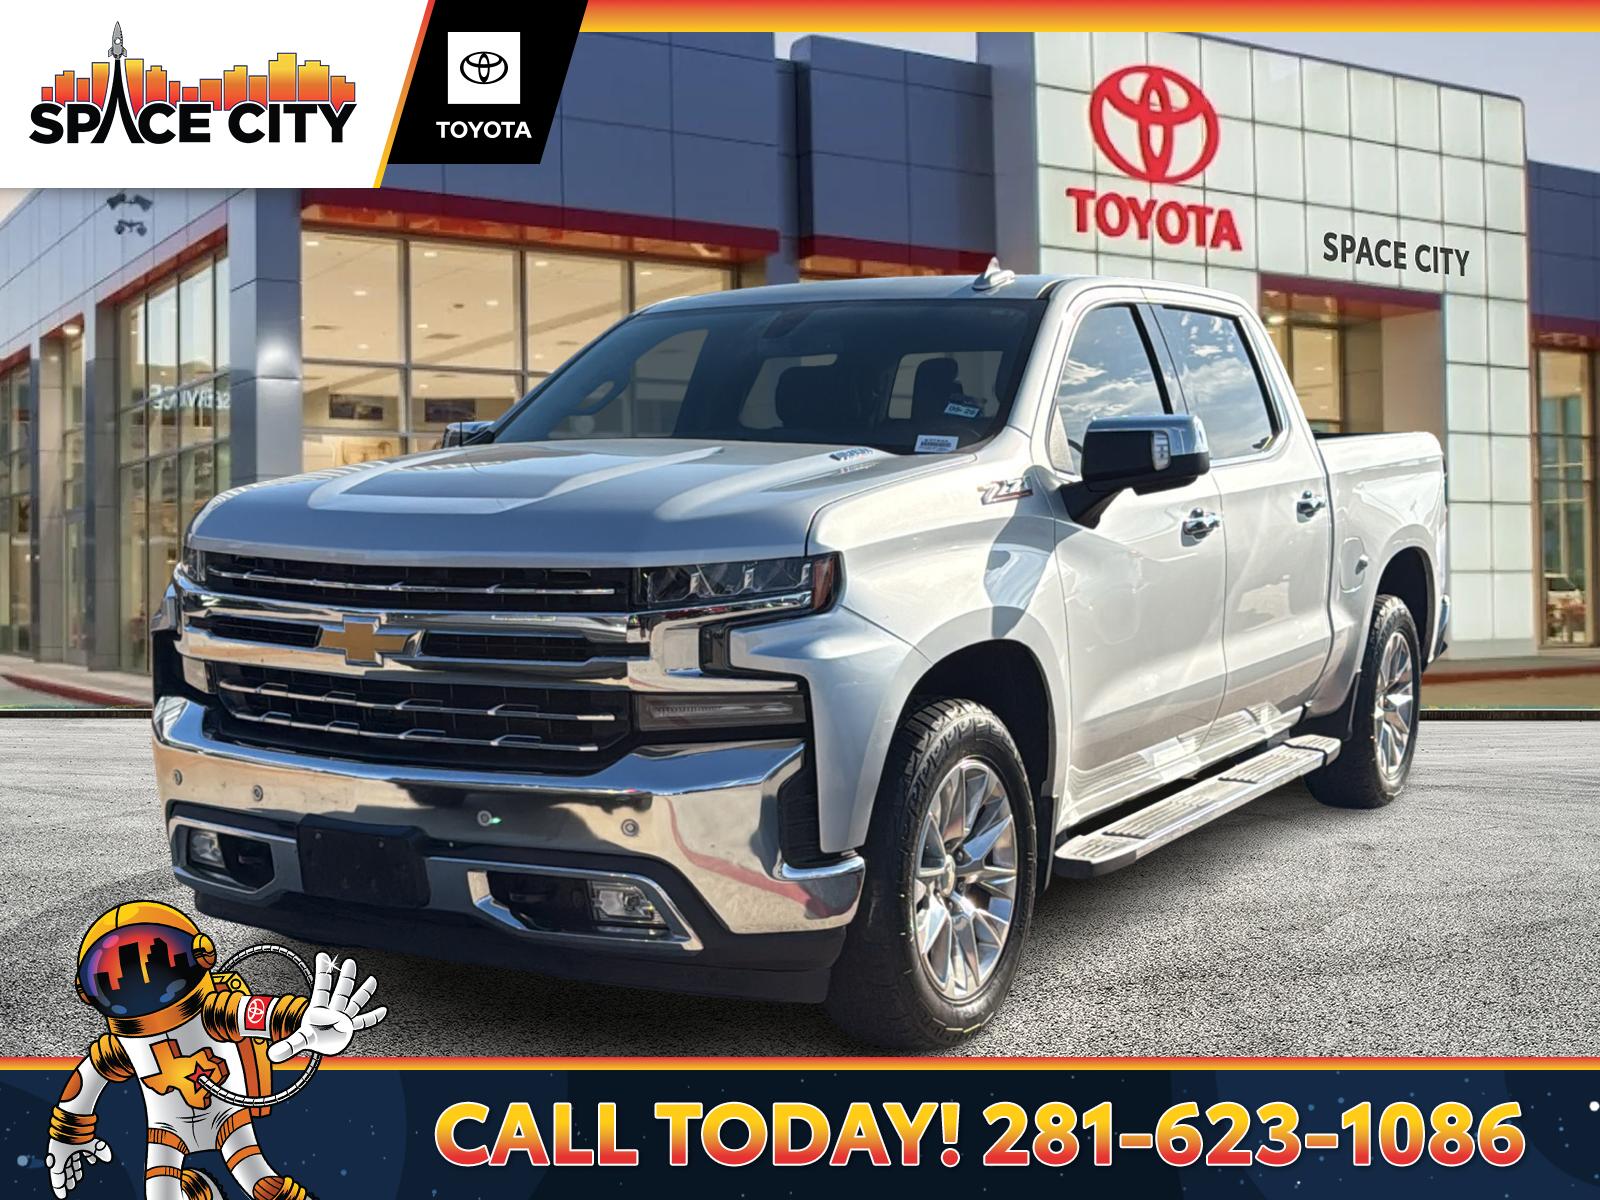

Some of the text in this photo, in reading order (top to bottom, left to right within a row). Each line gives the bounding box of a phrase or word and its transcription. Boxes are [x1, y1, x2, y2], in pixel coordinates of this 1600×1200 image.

[1066, 187, 1243, 251] TOYOTA
[1323, 232, 1471, 277] SPACE CITY
